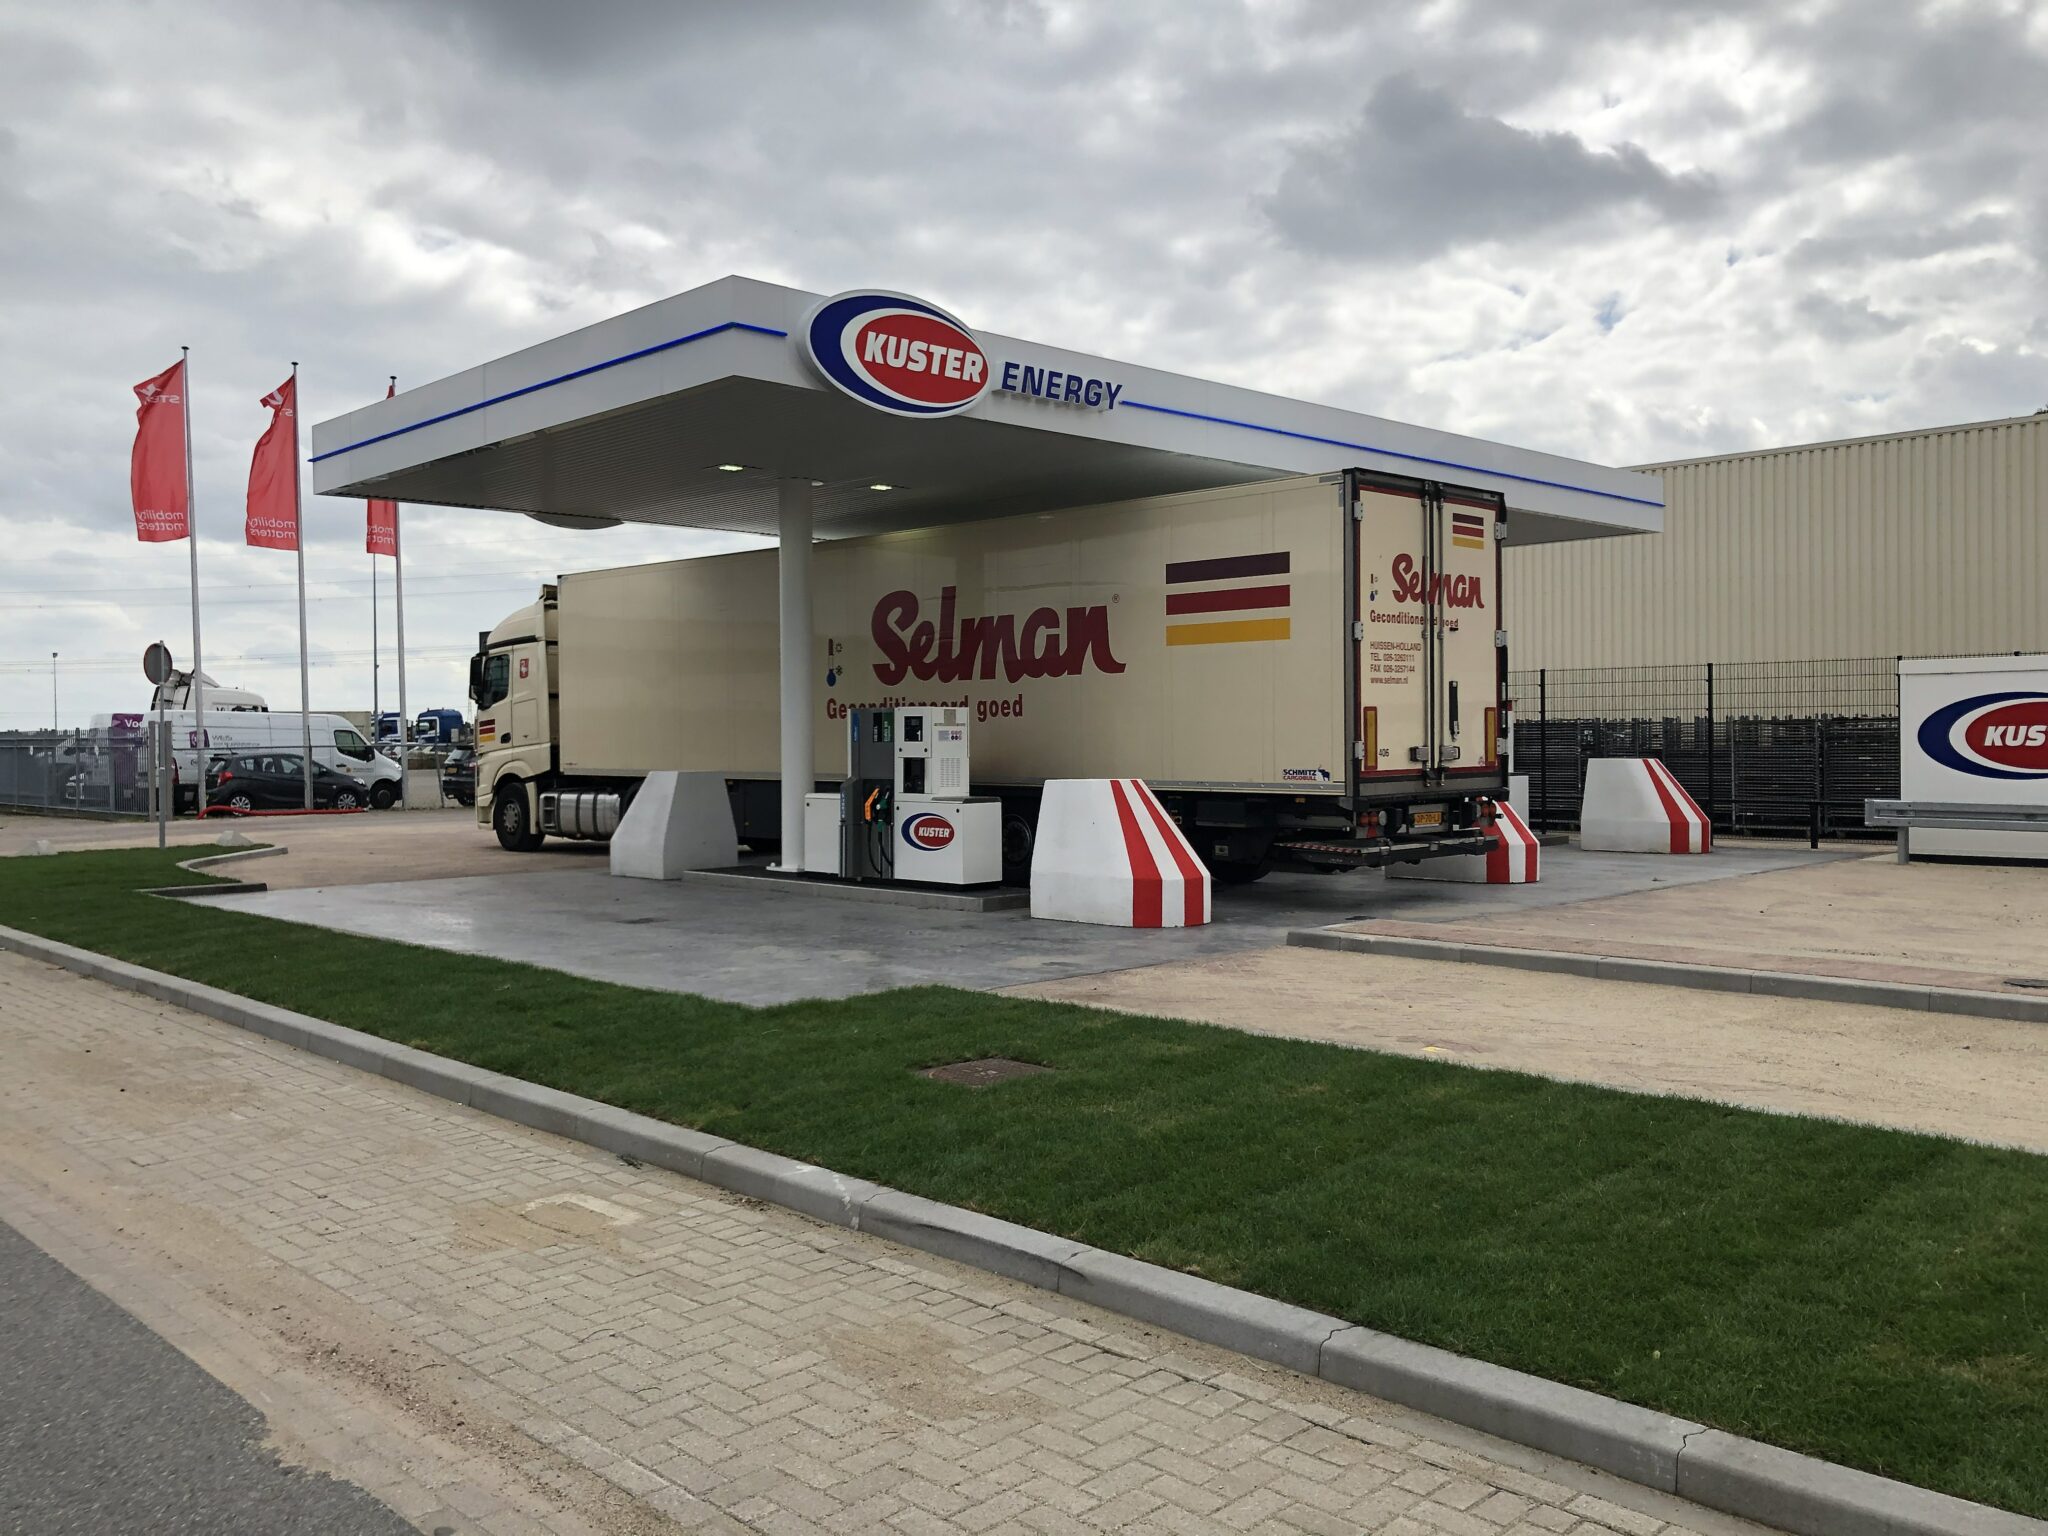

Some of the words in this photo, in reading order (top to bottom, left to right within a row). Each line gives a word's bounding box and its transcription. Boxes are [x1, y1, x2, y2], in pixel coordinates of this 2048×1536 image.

[864, 331, 985, 384] KUSTER
[1001, 361, 1124, 411] ENERGY
[1392, 553, 1485, 609] Selman
[1370, 610, 1438, 626] Geconditioned
[871, 586, 1127, 686] Selman
[976, 694, 1023, 723] goed
[1984, 725, 2048, 747] KUS
[1283, 768, 1317, 776] SCHMITZ
[918, 827, 951, 839] KUSTER
